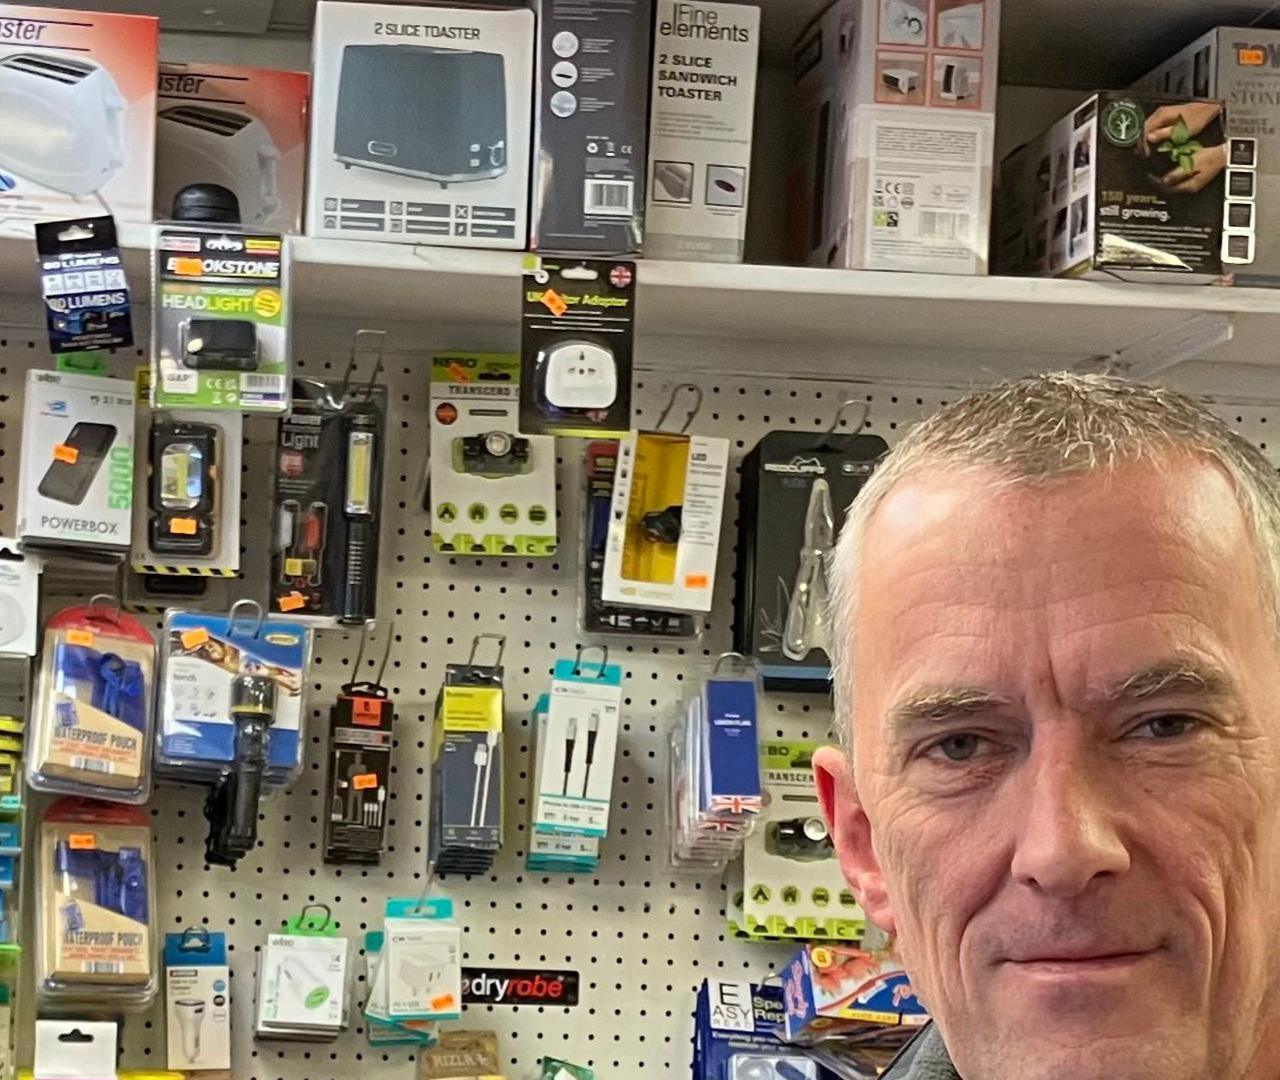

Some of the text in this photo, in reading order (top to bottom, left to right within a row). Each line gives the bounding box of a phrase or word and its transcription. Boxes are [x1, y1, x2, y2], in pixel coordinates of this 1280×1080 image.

[375, 22, 481, 41] 2 SLICE TOASTER
[659, 20, 750, 43] elements
[659, 54, 713, 69] 2 SLICE
[658, 70, 738, 87] SANDWICH
[657, 86, 723, 102] TOASTER
[166, 257, 280, 277] BOKSTONE
[68, 292, 126, 309] LUMENS
[162, 295, 252, 312] HEADLIGHT
[281, 432, 320, 450] Light
[41, 516, 119, 534] POWERBOX
[768, 772, 815, 783] RANSCEN
[471, 972, 565, 1001] dryrobe
